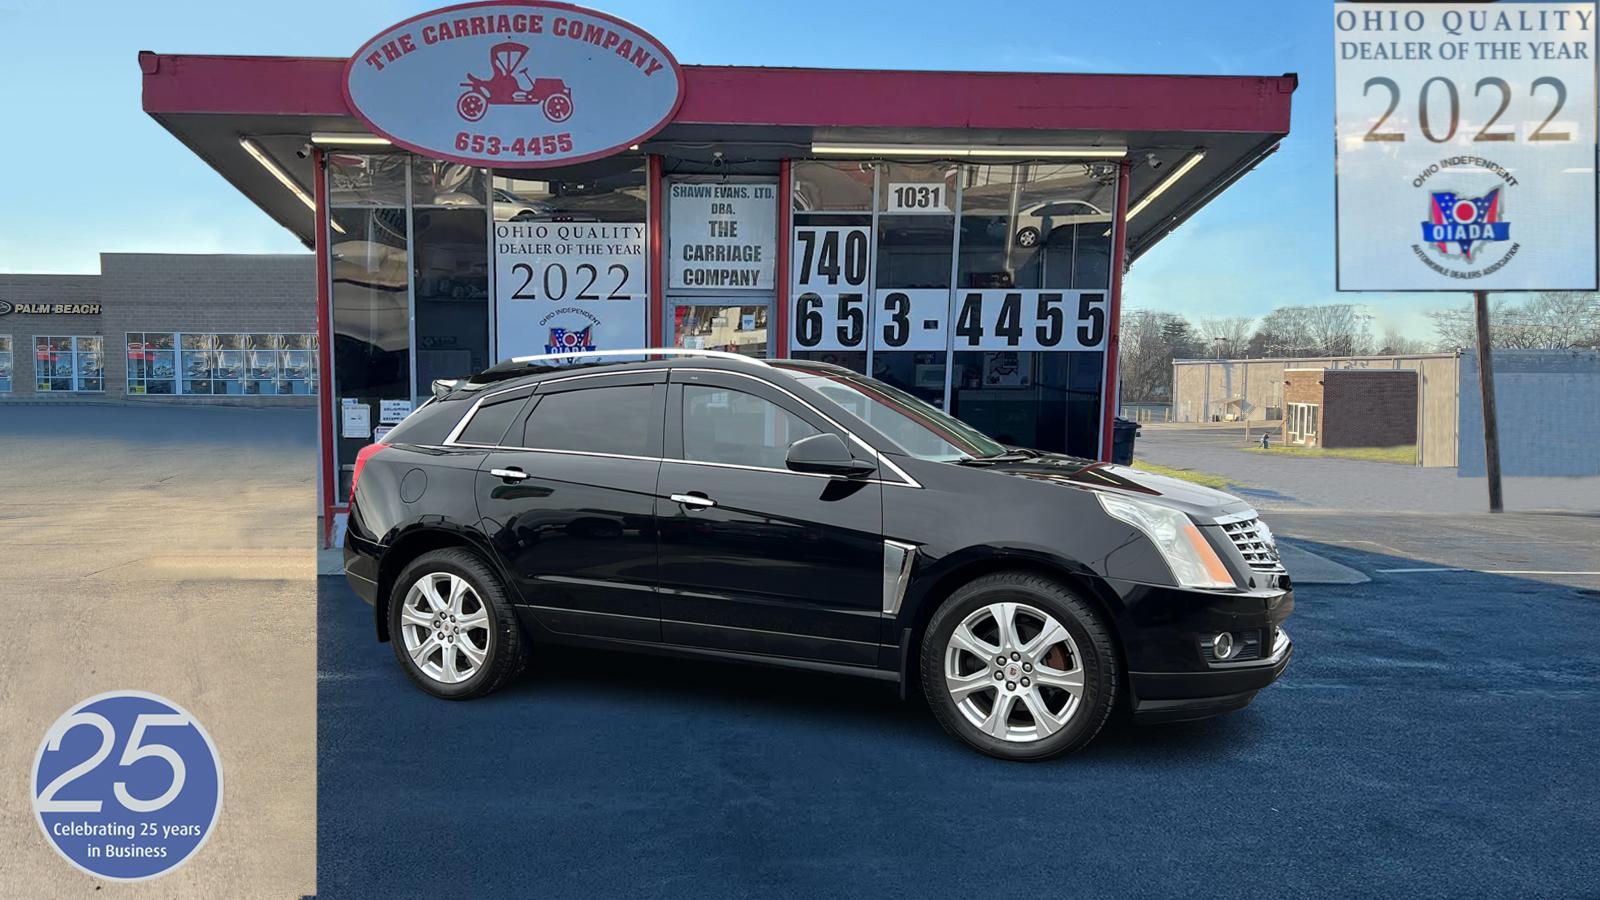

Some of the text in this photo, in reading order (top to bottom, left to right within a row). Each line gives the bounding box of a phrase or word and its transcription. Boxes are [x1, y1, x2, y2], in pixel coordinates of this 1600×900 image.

[1336, 10, 1592, 35] OHIO QUALITY
[366, 14, 665, 77] THE CARRIAGE COMPANY
[1341, 42, 1589, 60] DEALER OF THE YEAR
[1363, 76, 1571, 143] 2022
[455, 131, 573, 157] 653-4455
[1413, 156, 1519, 188] OHIO INDEPENDENT
[673, 186, 711, 198] SHAWN
[754, 187, 775, 199] LTD.
[895, 187, 940, 208] 1031
[711, 203, 736, 214] DBA.
[497, 226, 644, 240] OHIO QUALITY
[708, 220, 738, 237] THE
[1433, 224, 1495, 240] OIADA
[499, 243, 641, 255] DEALER OF THE YEAR
[683, 244, 762, 262] CARRIAGE
[797, 230, 868, 286] 740
[511, 263, 631, 300] 2022
[683, 268, 760, 286] COMPANY
[1449, 270, 1482, 279] DEALERS
[15, 304, 50, 314] PALM
[539, 307, 601, 326] OHIO INDEPENDENT
